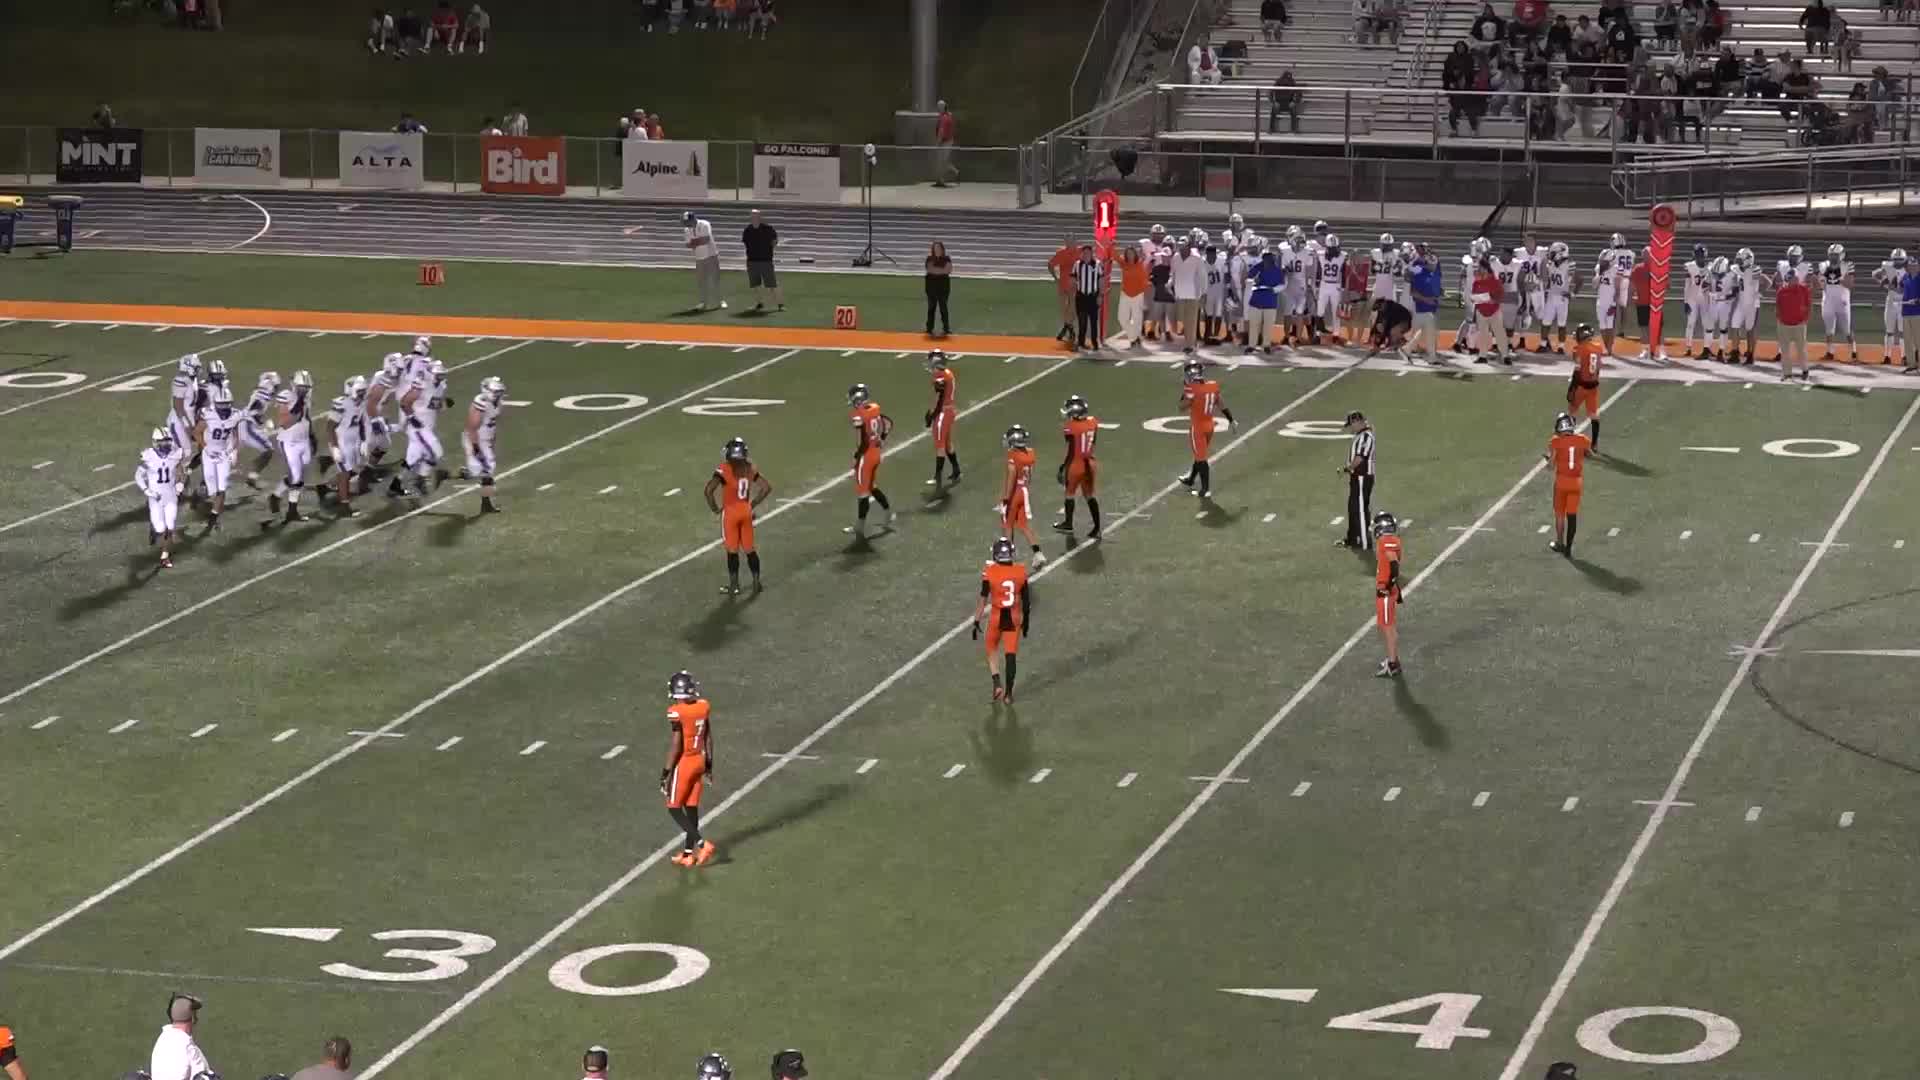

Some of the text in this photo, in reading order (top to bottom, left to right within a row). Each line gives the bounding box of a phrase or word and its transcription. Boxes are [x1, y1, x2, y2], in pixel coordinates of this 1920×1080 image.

[352, 156, 412, 168] ALTA
[488, 147, 558, 184] Bird
[632, 160, 678, 177] Alpine
[1100, 201, 1109, 228] 1
[423, 265, 437, 282] 10
[1324, 263, 1339, 277] 29
[837, 308, 853, 326] 20
[1589, 352, 1598, 375] 8
[1568, 446, 1576, 470] 1
[156, 465, 171, 484] 11
[738, 477, 750, 500] 0
[1001, 580, 1015, 607] 3
[692, 719, 705, 749] 7
[320, 928, 711, 996] 30
[1325, 992, 1742, 1065] 40
